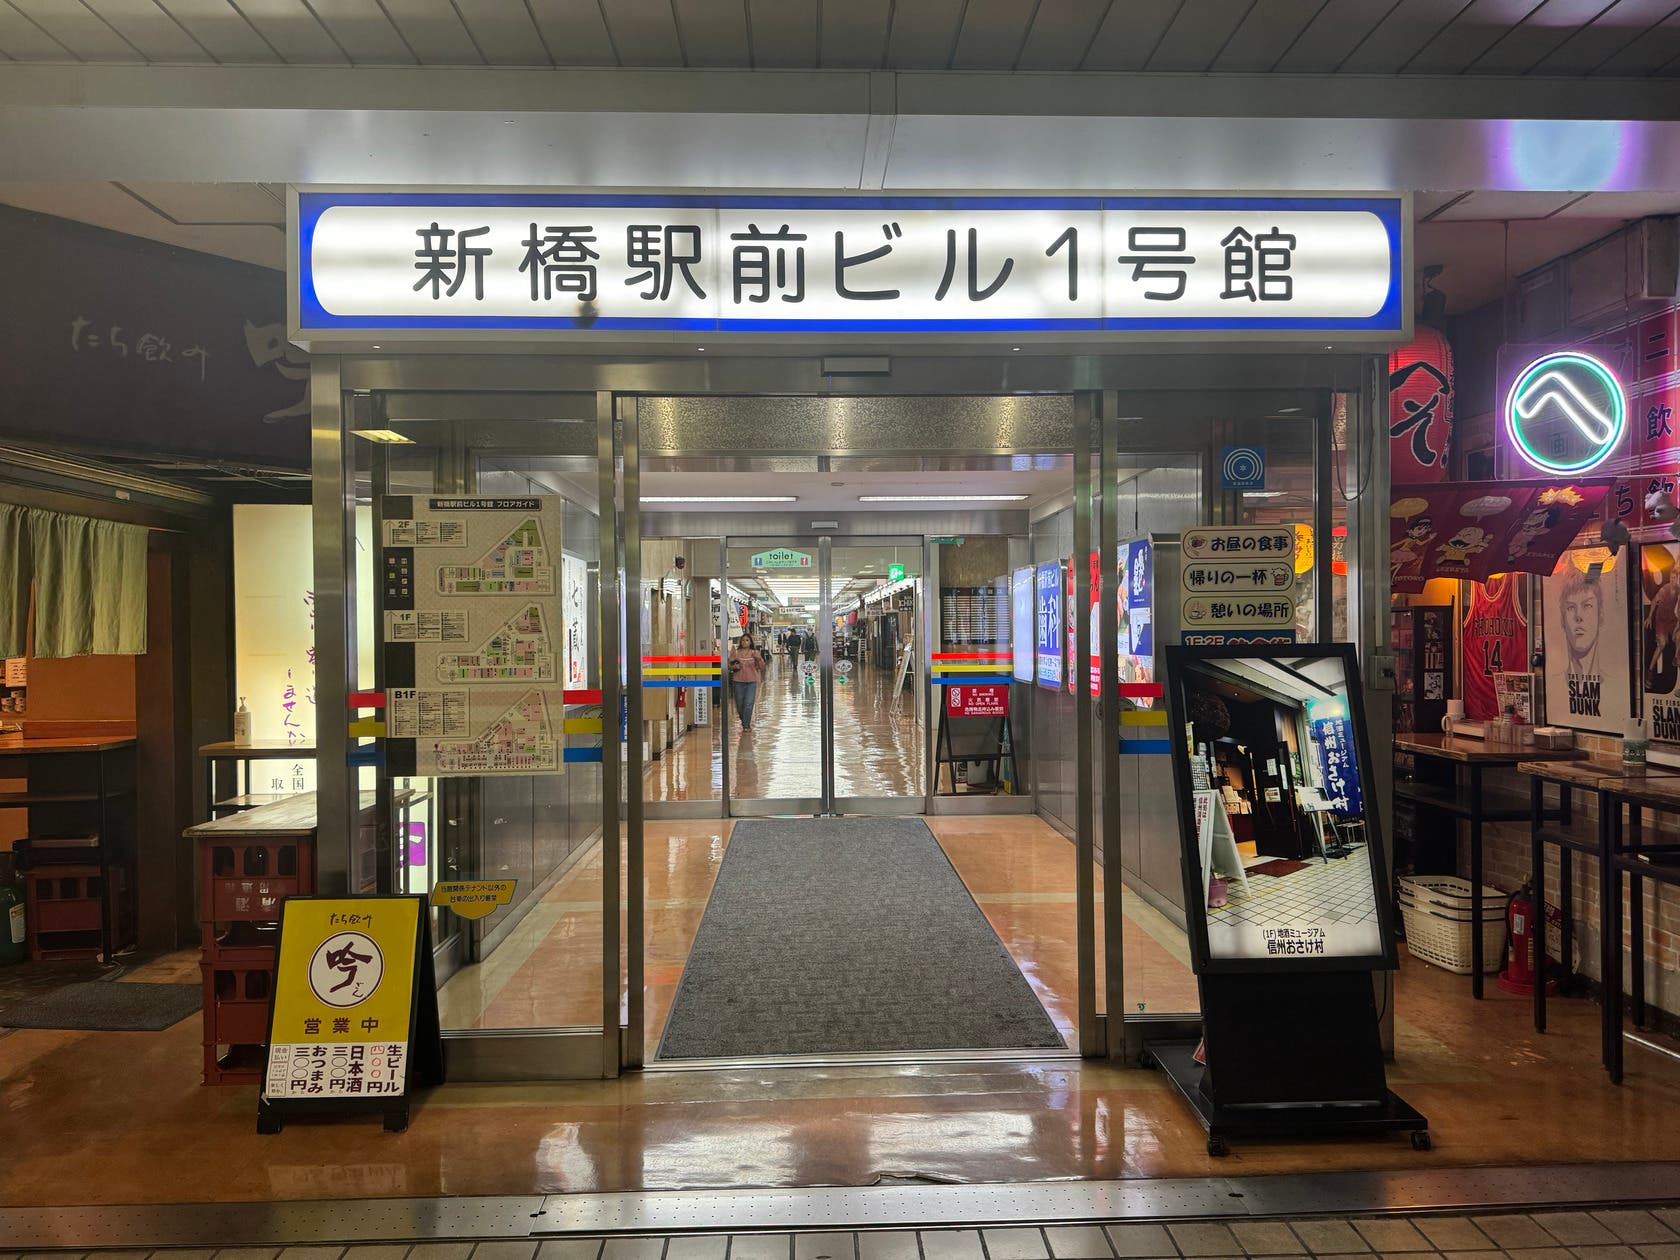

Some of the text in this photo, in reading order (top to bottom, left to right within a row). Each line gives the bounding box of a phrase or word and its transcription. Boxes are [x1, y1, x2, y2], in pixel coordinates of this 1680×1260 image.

[412, 221, 1297, 304] 新橋駅前ビル1号館
[1211, 536, 1289, 551] お昼の食事
[769, 551, 793, 560] toilet
[1190, 569, 1268, 586] 帰りの一杯
[1211, 603, 1289, 618] 憩いの場所
[1482, 640, 1503, 676] 14
[395, 691, 416, 699] B1F
[1568, 680, 1601, 699] SLAM
[1569, 698, 1602, 717] DUNK
[330, 912, 372, 928] たち飲み
[1262, 929, 1277, 940] (1F)
[1267, 939, 1324, 955] 信州おさけ村
[326, 941, 374, 993] 吟
[304, 1017, 379, 1035] 営業中
[307, 1046, 328, 1094] おつまみ
[346, 1045, 365, 1093] 日本酒
[384, 1044, 403, 1093] 生ビール
